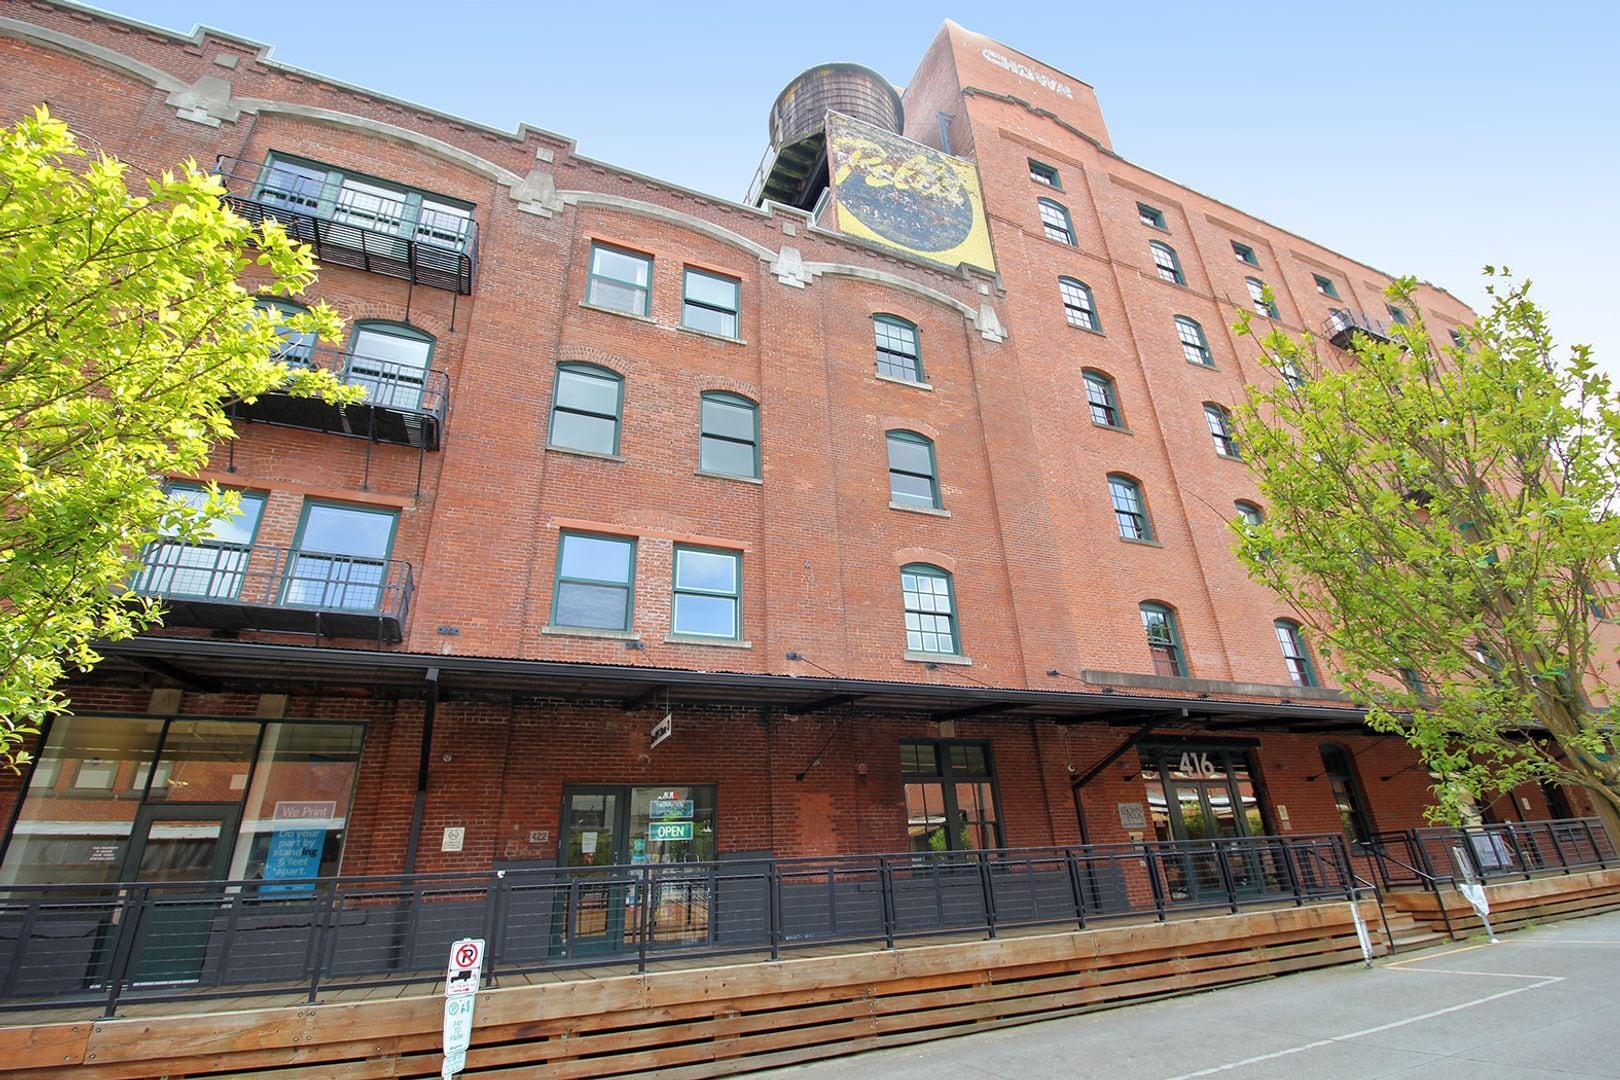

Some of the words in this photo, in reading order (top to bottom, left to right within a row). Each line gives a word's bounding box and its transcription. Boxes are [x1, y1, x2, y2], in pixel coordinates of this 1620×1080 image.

[1179, 752, 1215, 778] 416
[282, 806, 300, 817] We
[303, 806, 328, 817] Print
[279, 830, 295, 838] Do
[296, 830, 320, 840] your
[657, 825, 685, 838] OPEN
[278, 840, 301, 849] part
[302, 839, 316, 848] by
[272, 848, 318, 858] standing
[277, 858, 286, 866] 6
[288, 857, 308, 866] feet
